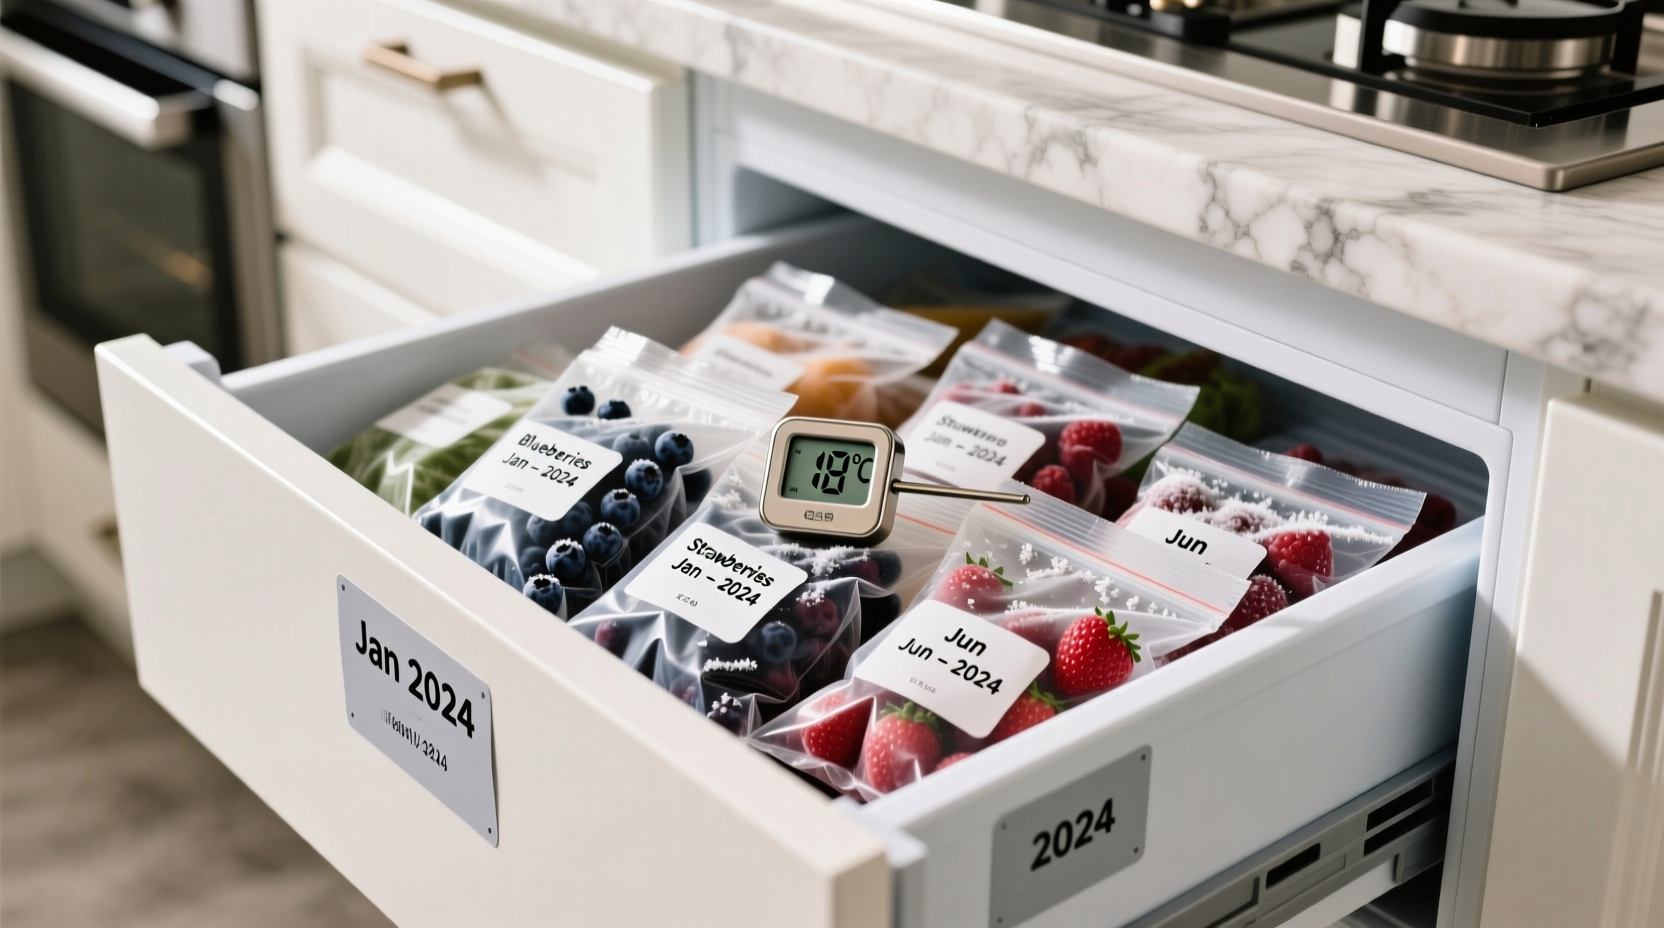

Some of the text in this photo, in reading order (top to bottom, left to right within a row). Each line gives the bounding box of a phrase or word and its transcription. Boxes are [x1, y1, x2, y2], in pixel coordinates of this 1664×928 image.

[502, 452, 529, 470] Jan
[540, 465, 579, 487] 2024
[967, 444, 1007, 467] 2024
[1165, 529, 1208, 555] Jun
[671, 558, 702, 579] Jan
[717, 577, 761, 607] 2024
[944, 628, 987, 657] Jun
[355, 619, 400, 683] Jan
[408, 658, 475, 739] 2024
[898, 638, 933, 661] Jun
[950, 659, 1003, 695] 2024
[1030, 797, 1116, 872] 2024
